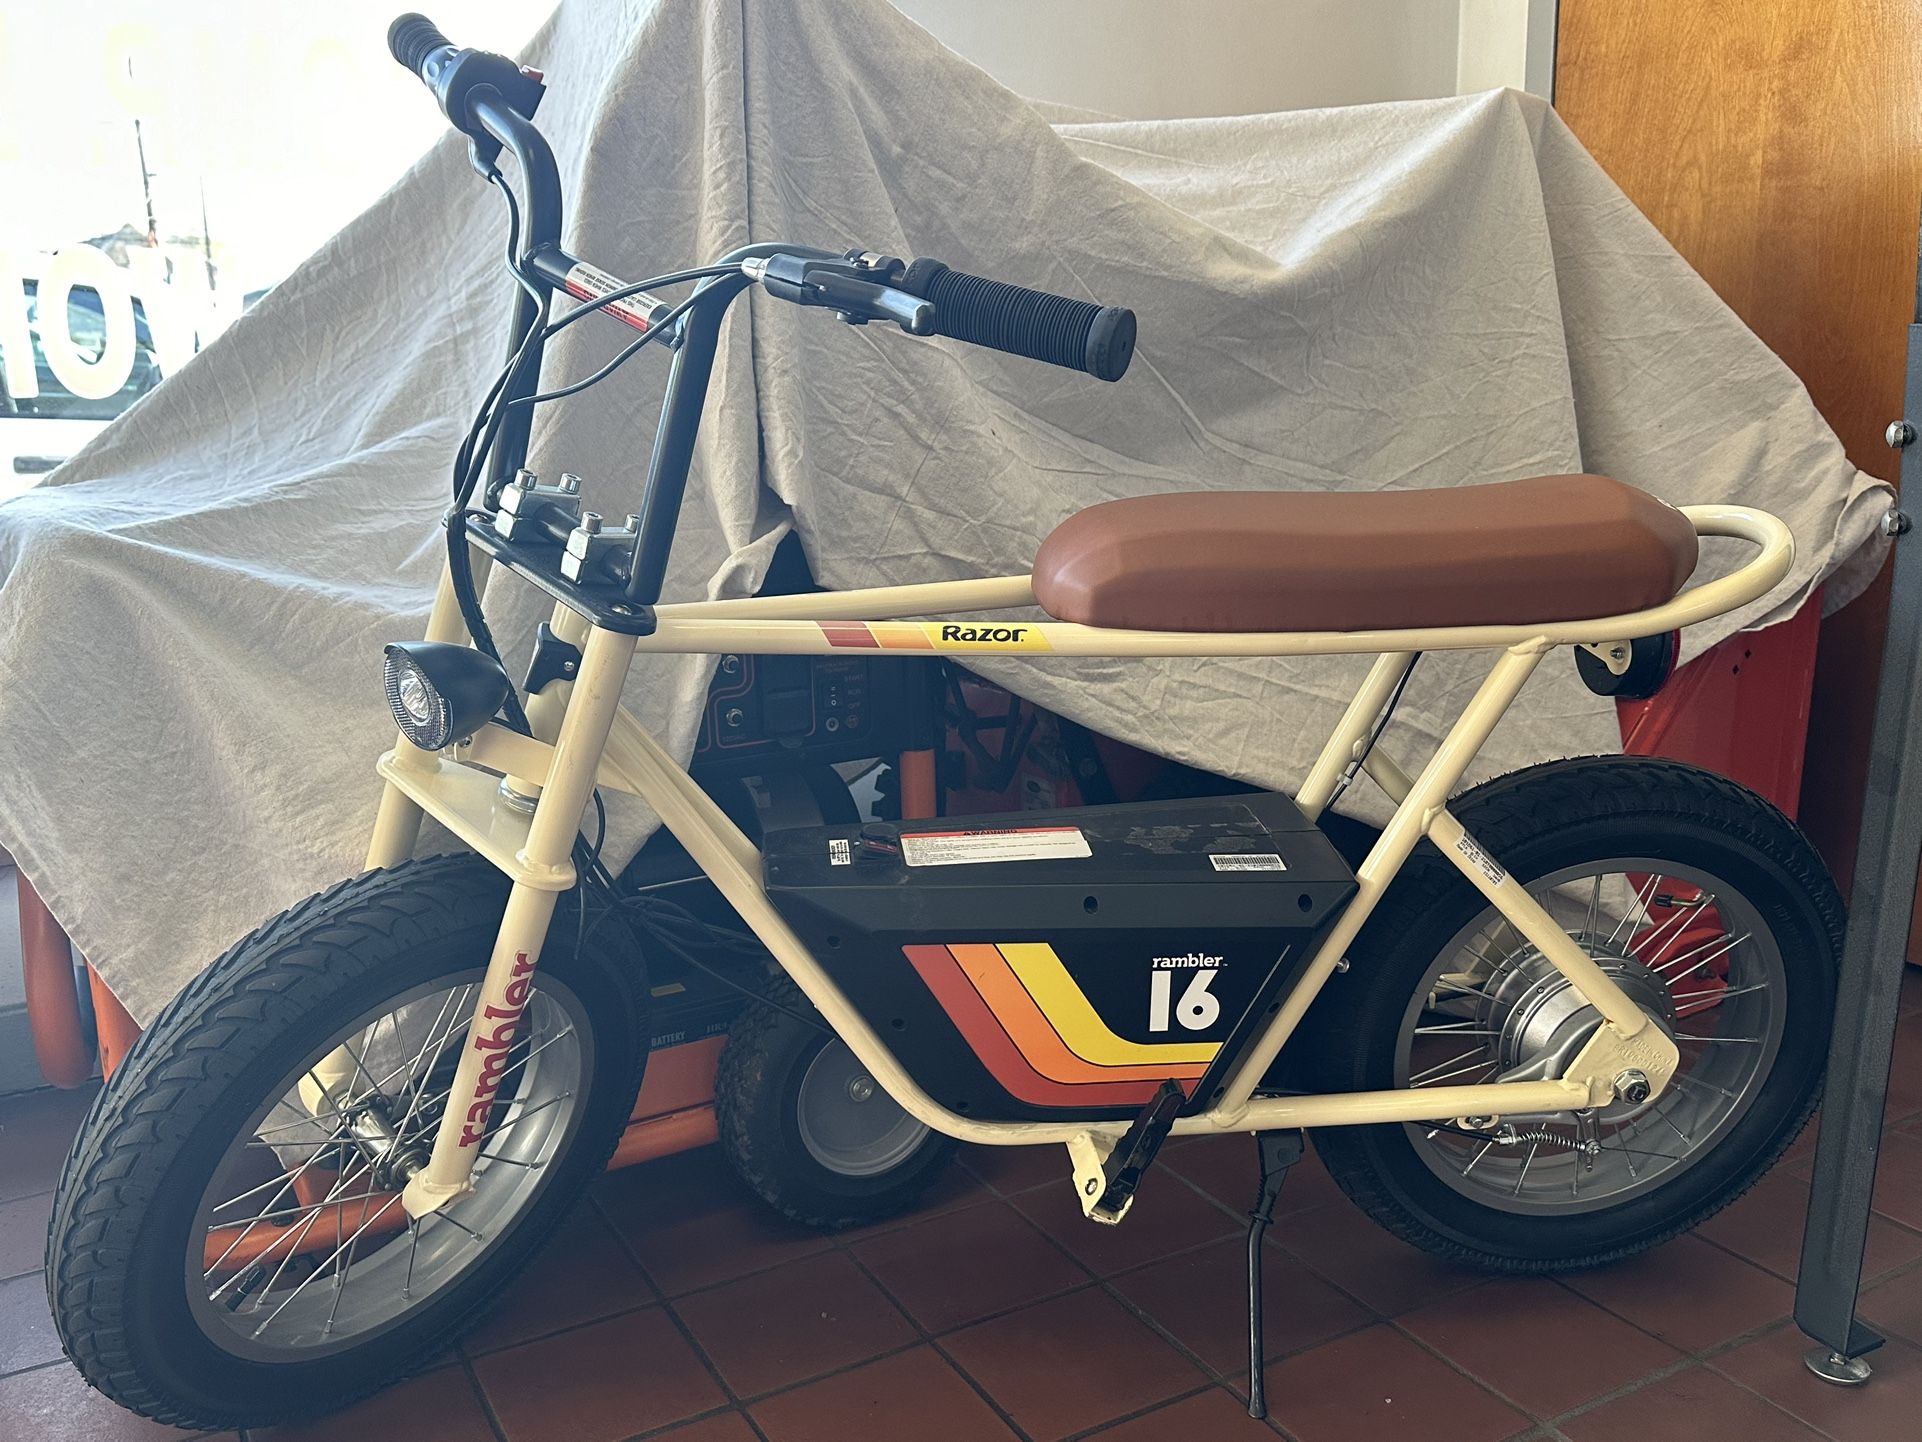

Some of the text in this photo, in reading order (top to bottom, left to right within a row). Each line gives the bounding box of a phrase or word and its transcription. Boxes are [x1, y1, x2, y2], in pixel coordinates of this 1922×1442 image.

[942, 625, 1027, 642] Razor
[1152, 953, 1223, 968] rambler
[1149, 969, 1220, 1032] 16
[651, 1031, 686, 1047] BATTERY
[459, 951, 538, 1147] rambler
